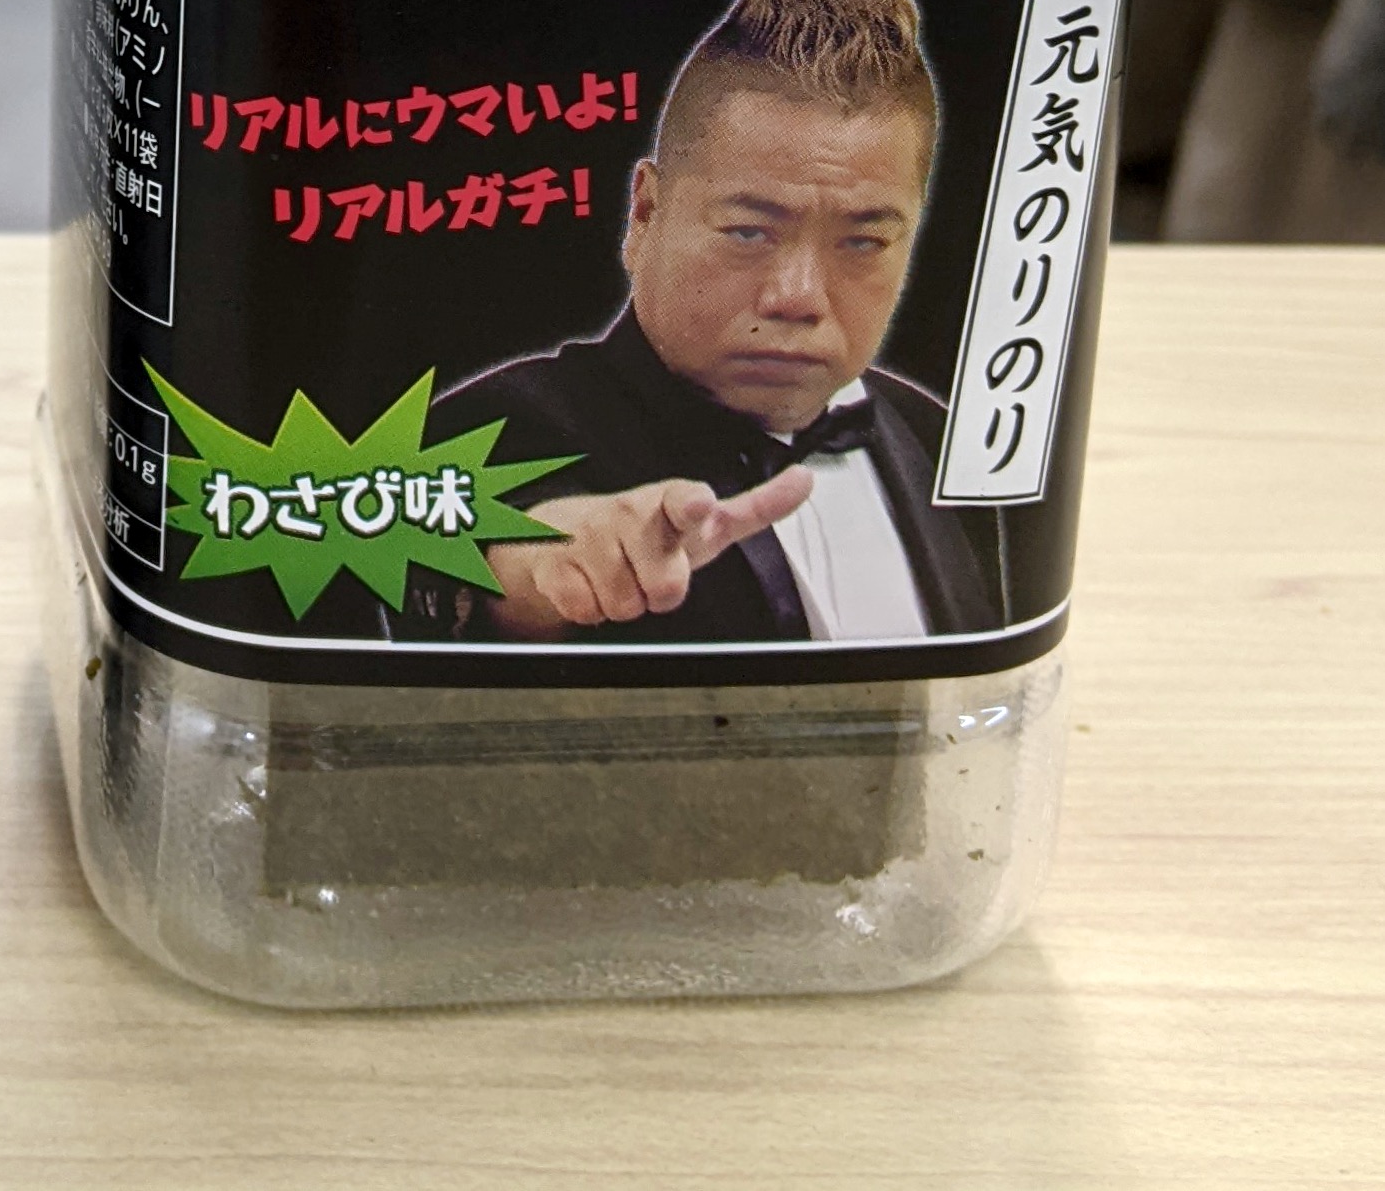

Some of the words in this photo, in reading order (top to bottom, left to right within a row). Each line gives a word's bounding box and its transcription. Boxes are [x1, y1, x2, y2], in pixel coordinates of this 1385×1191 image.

[189, 71, 639, 152] リアルにウマいよ!
[273, 167, 591, 243] リアルガチ!
[984, 5, 1101, 475] 元気のりのり
[203, 467, 477, 541] わさび味
